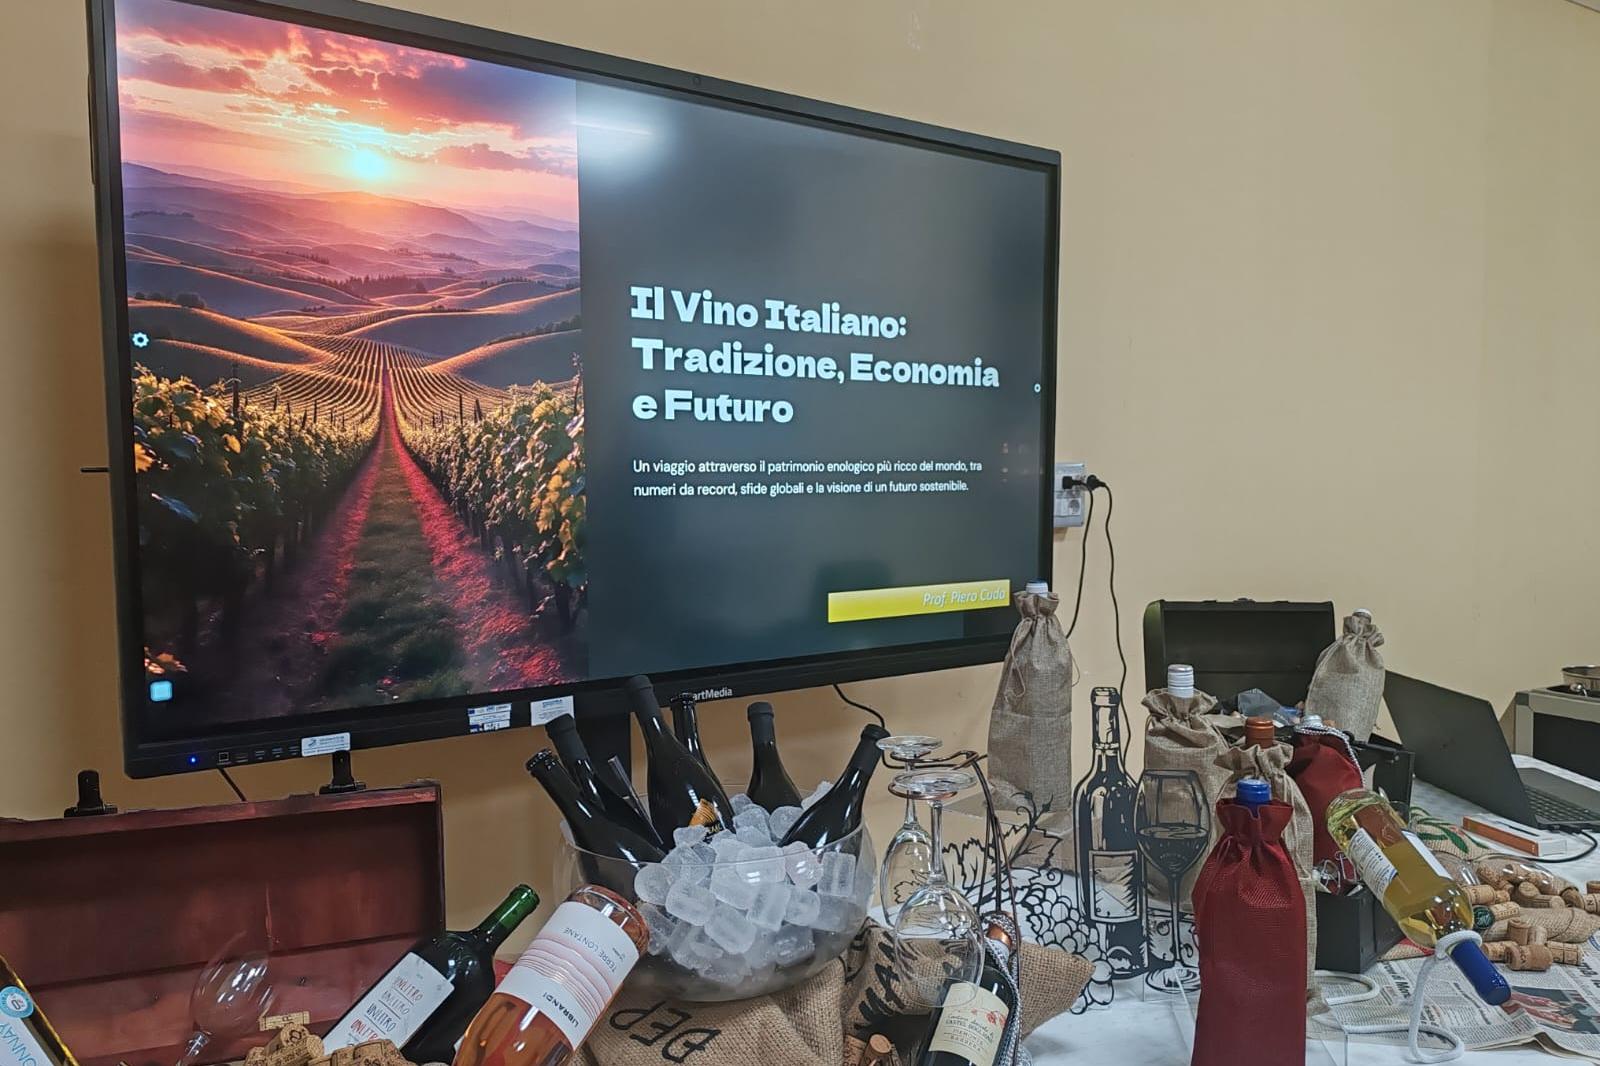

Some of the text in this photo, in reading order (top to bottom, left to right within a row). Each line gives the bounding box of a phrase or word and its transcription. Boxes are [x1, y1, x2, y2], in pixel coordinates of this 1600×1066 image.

[631, 286, 906, 338] Il Vino Italiano:
[632, 337, 999, 387] Tradizione, Economia
[632, 389, 793, 423] e Futuro
[633, 460, 982, 475] Un viaggio attraverso il patrimonio enologico più ricco del mondo, tra
[634, 480, 969, 497] numeri da record, sfide globali e la visione di un futuro sostenibile.
[692, 686, 732, 700] artMedia
[563, 926, 599, 953] LONTANE
[599, 949, 617, 973] TERRE
[543, 991, 579, 1028] LIBRANDI
